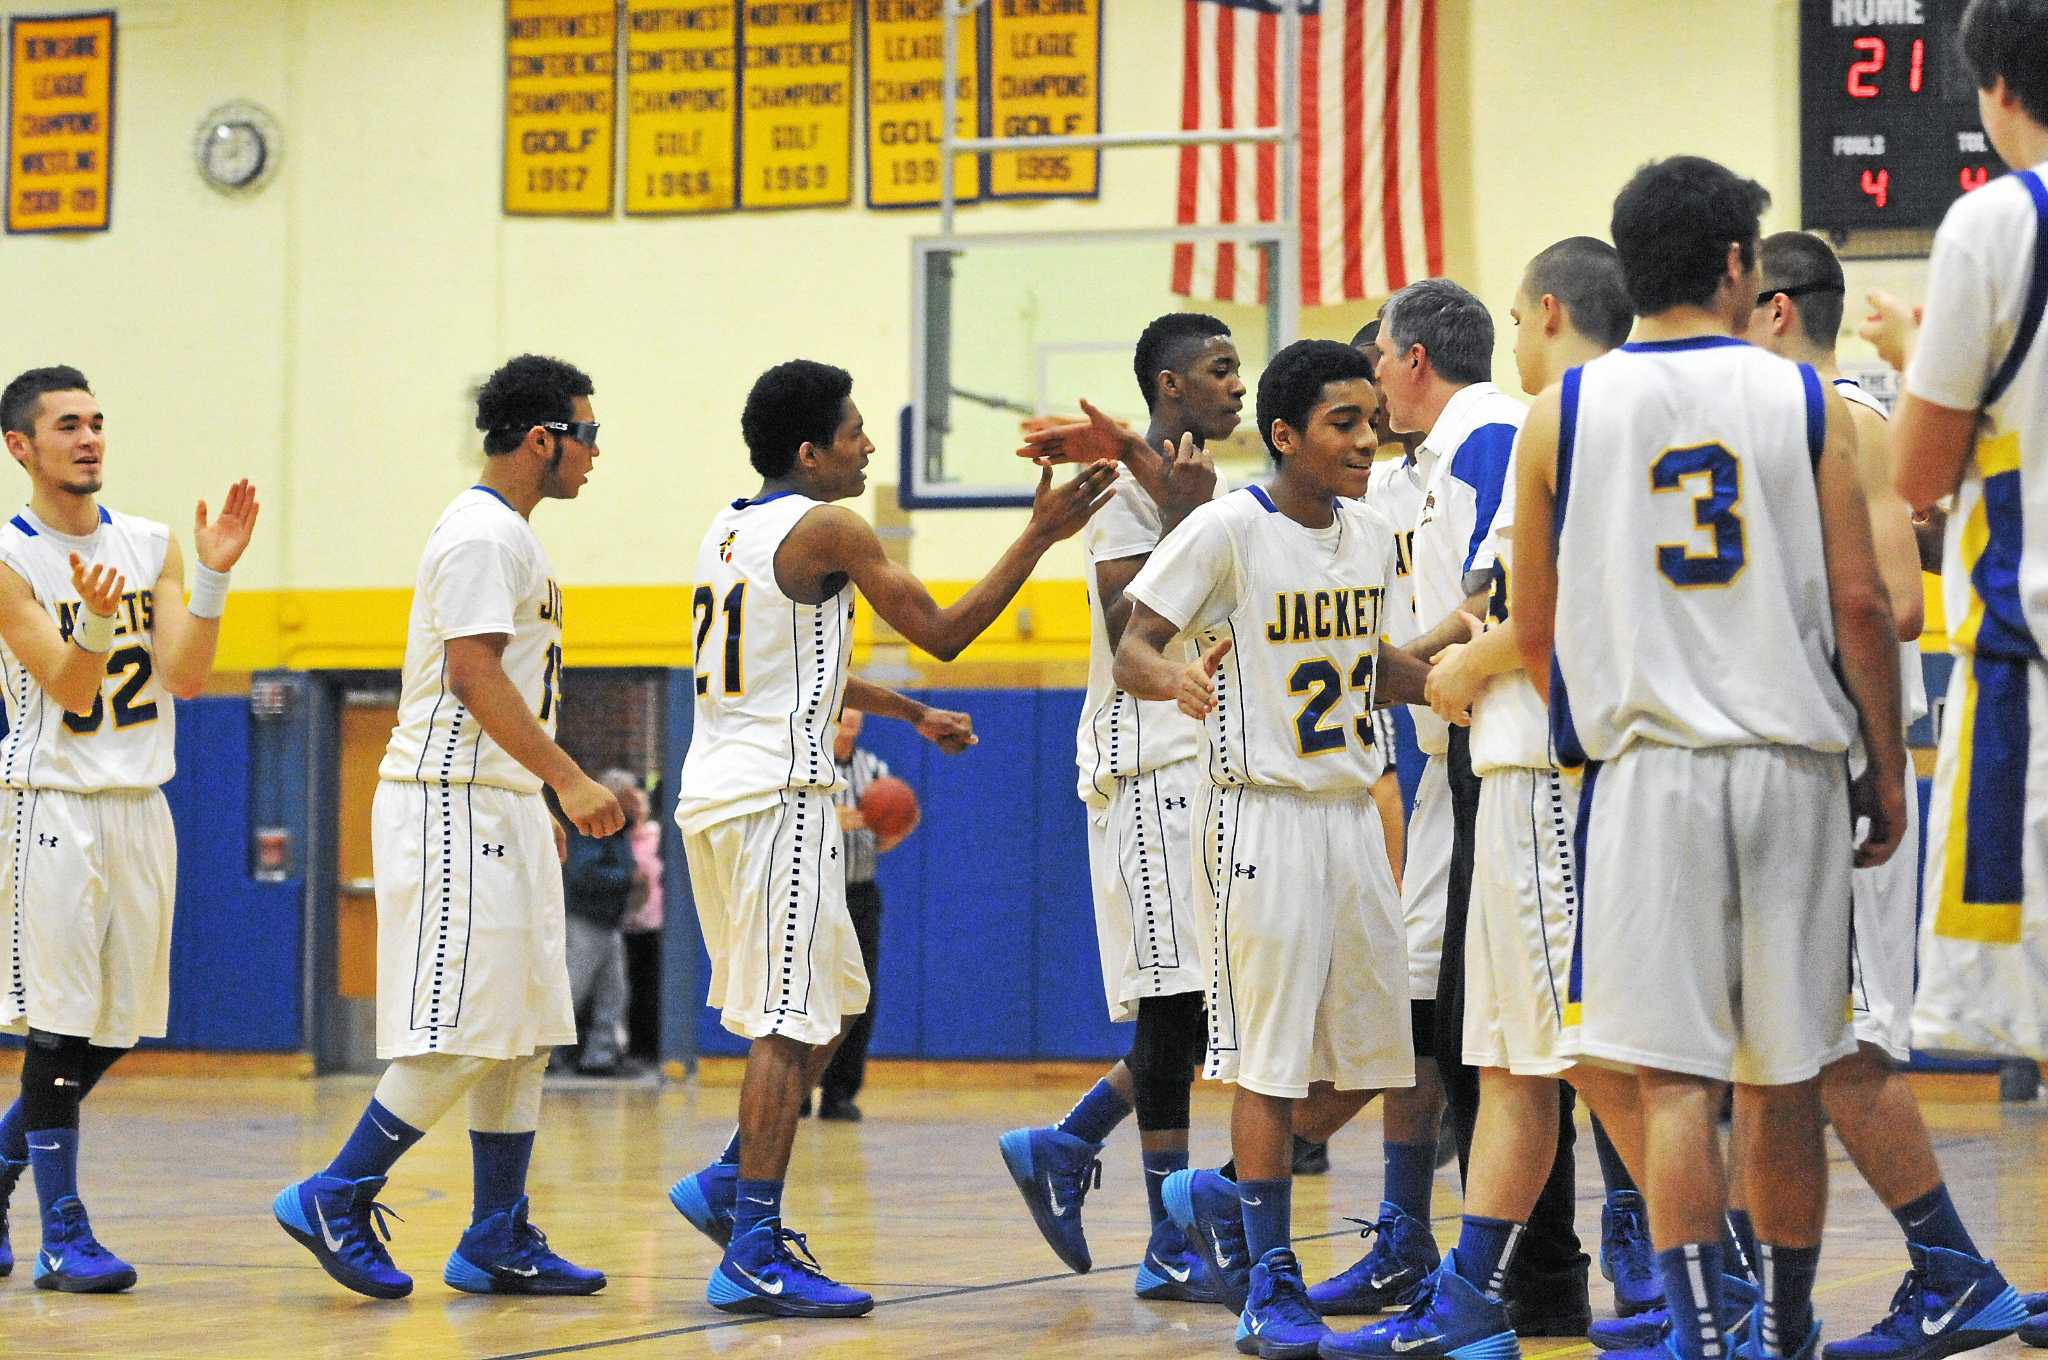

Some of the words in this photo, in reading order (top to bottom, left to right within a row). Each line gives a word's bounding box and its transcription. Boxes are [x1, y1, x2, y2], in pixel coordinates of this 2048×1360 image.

[1831, 0, 1925, 26] HOME
[884, 34, 944, 62] LEAGU
[1847, 36, 1925, 98] 21
[521, 128, 598, 154] GOLF
[1003, 114, 1083, 137] GOLF
[891, 159, 939, 186] 199
[1860, 168, 1889, 208] 4
[1649, 439, 1748, 590] 3
[1265, 586, 1385, 642] JACKET
[693, 578, 748, 697] 21
